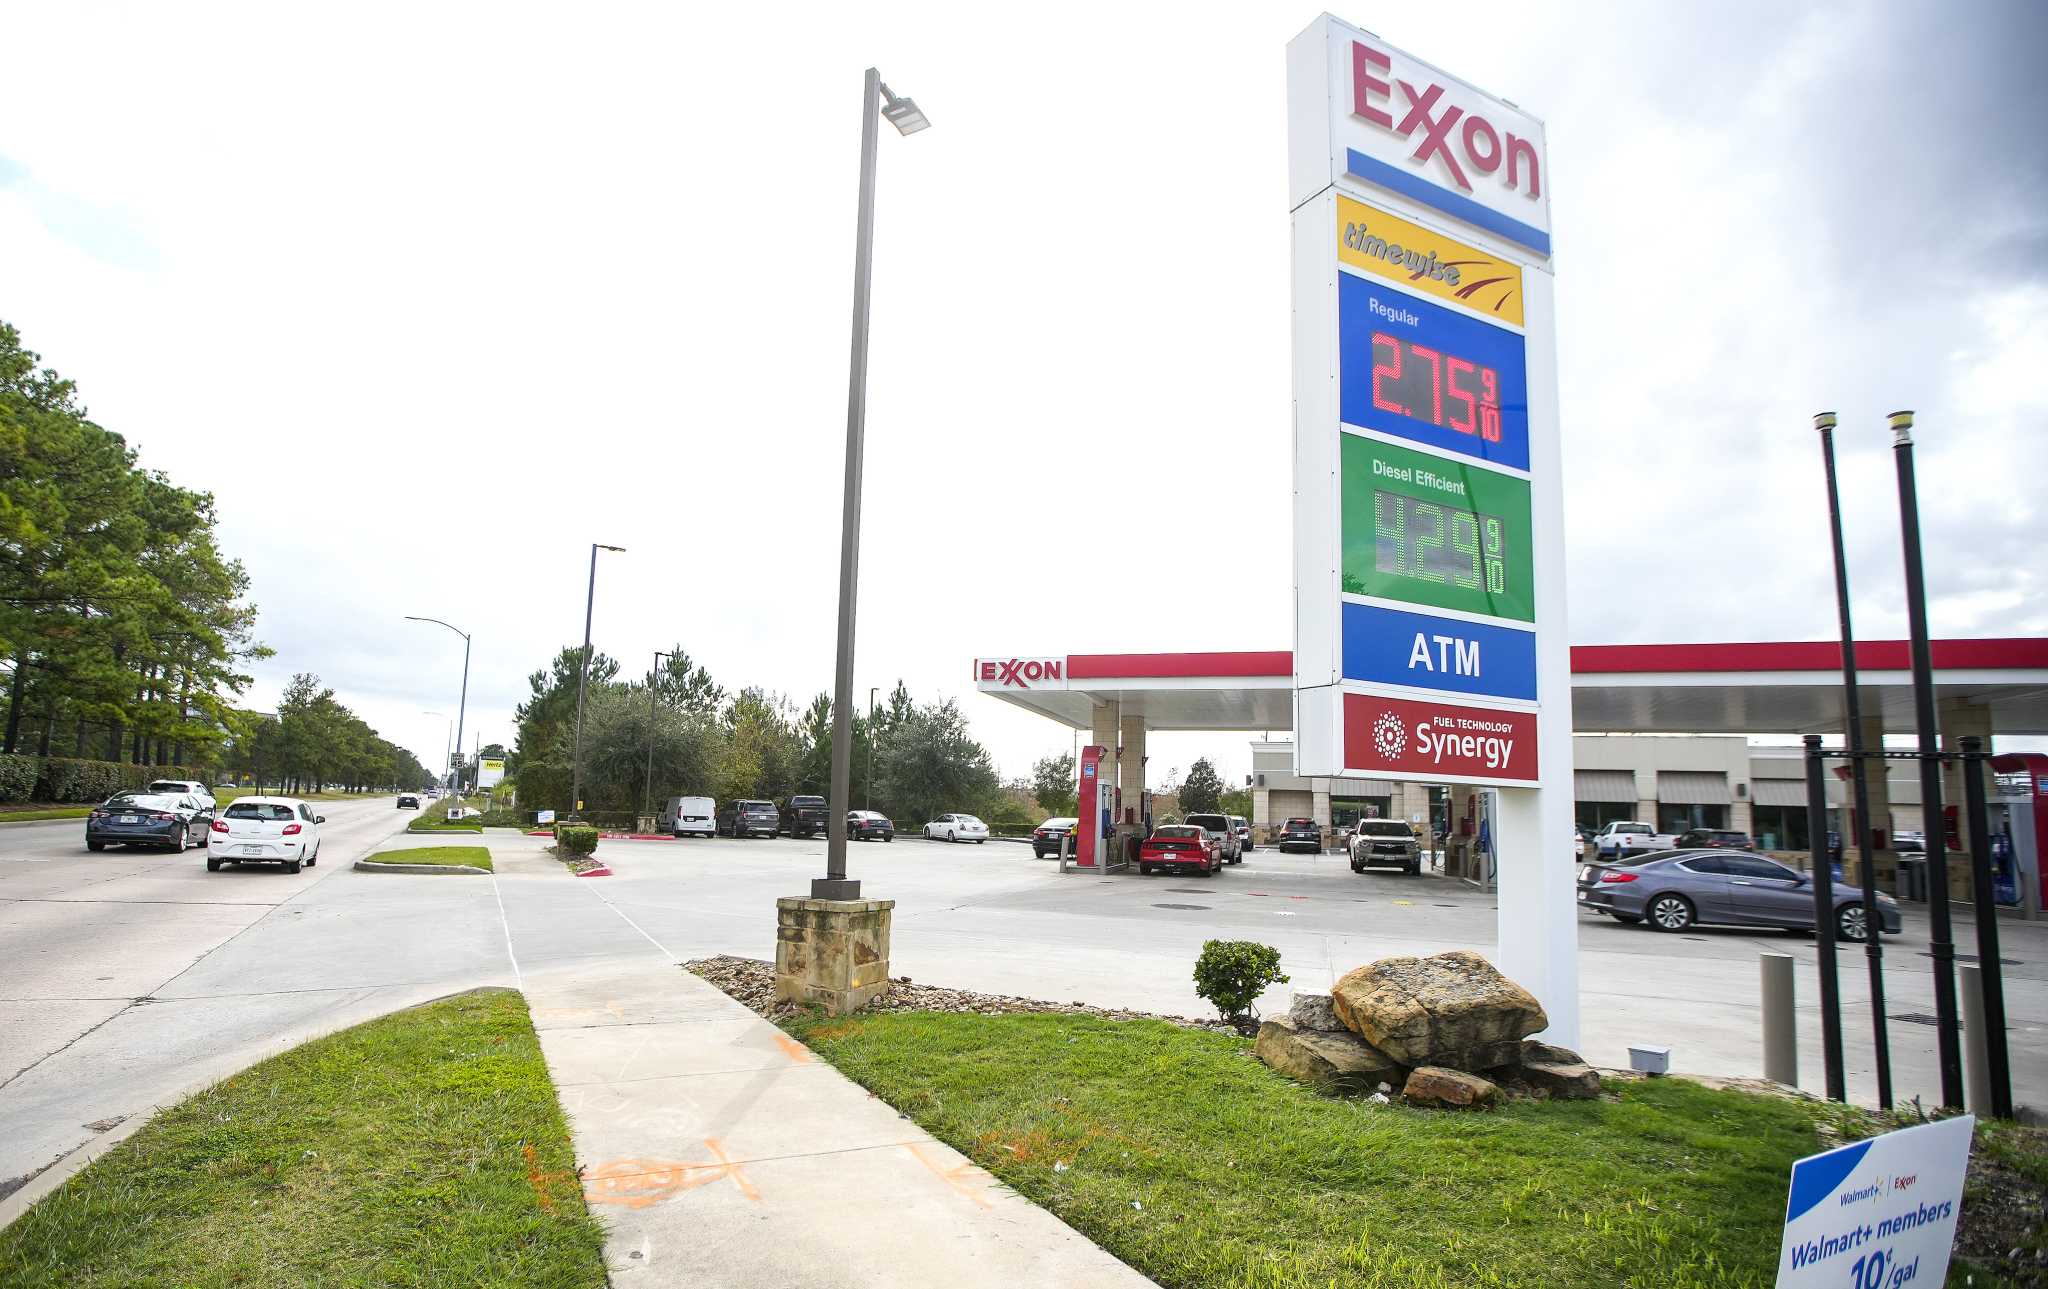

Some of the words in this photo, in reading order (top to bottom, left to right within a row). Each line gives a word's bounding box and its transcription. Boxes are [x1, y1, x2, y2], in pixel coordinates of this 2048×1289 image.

[1350, 39, 1541, 201] Exxon
[1343, 221, 1461, 287] timewise
[1369, 297, 1419, 327] Regular
[1371, 332, 1476, 435] 2.75
[1372, 459, 1412, 483] Diesel
[1415, 471, 1465, 496] Efficient
[981, 658, 1062, 689] EXXON
[1408, 632, 1480, 677] ATM
[1416, 722, 1514, 769] Synergy
[1433, 716, 1455, 729] FUEL
[1456, 718, 1513, 734] TECHNOLOGY
[1895, 1175, 1916, 1190] Exxon
[1791, 1224, 1873, 1271] Walmart+
[1877, 1200, 1952, 1240] members
